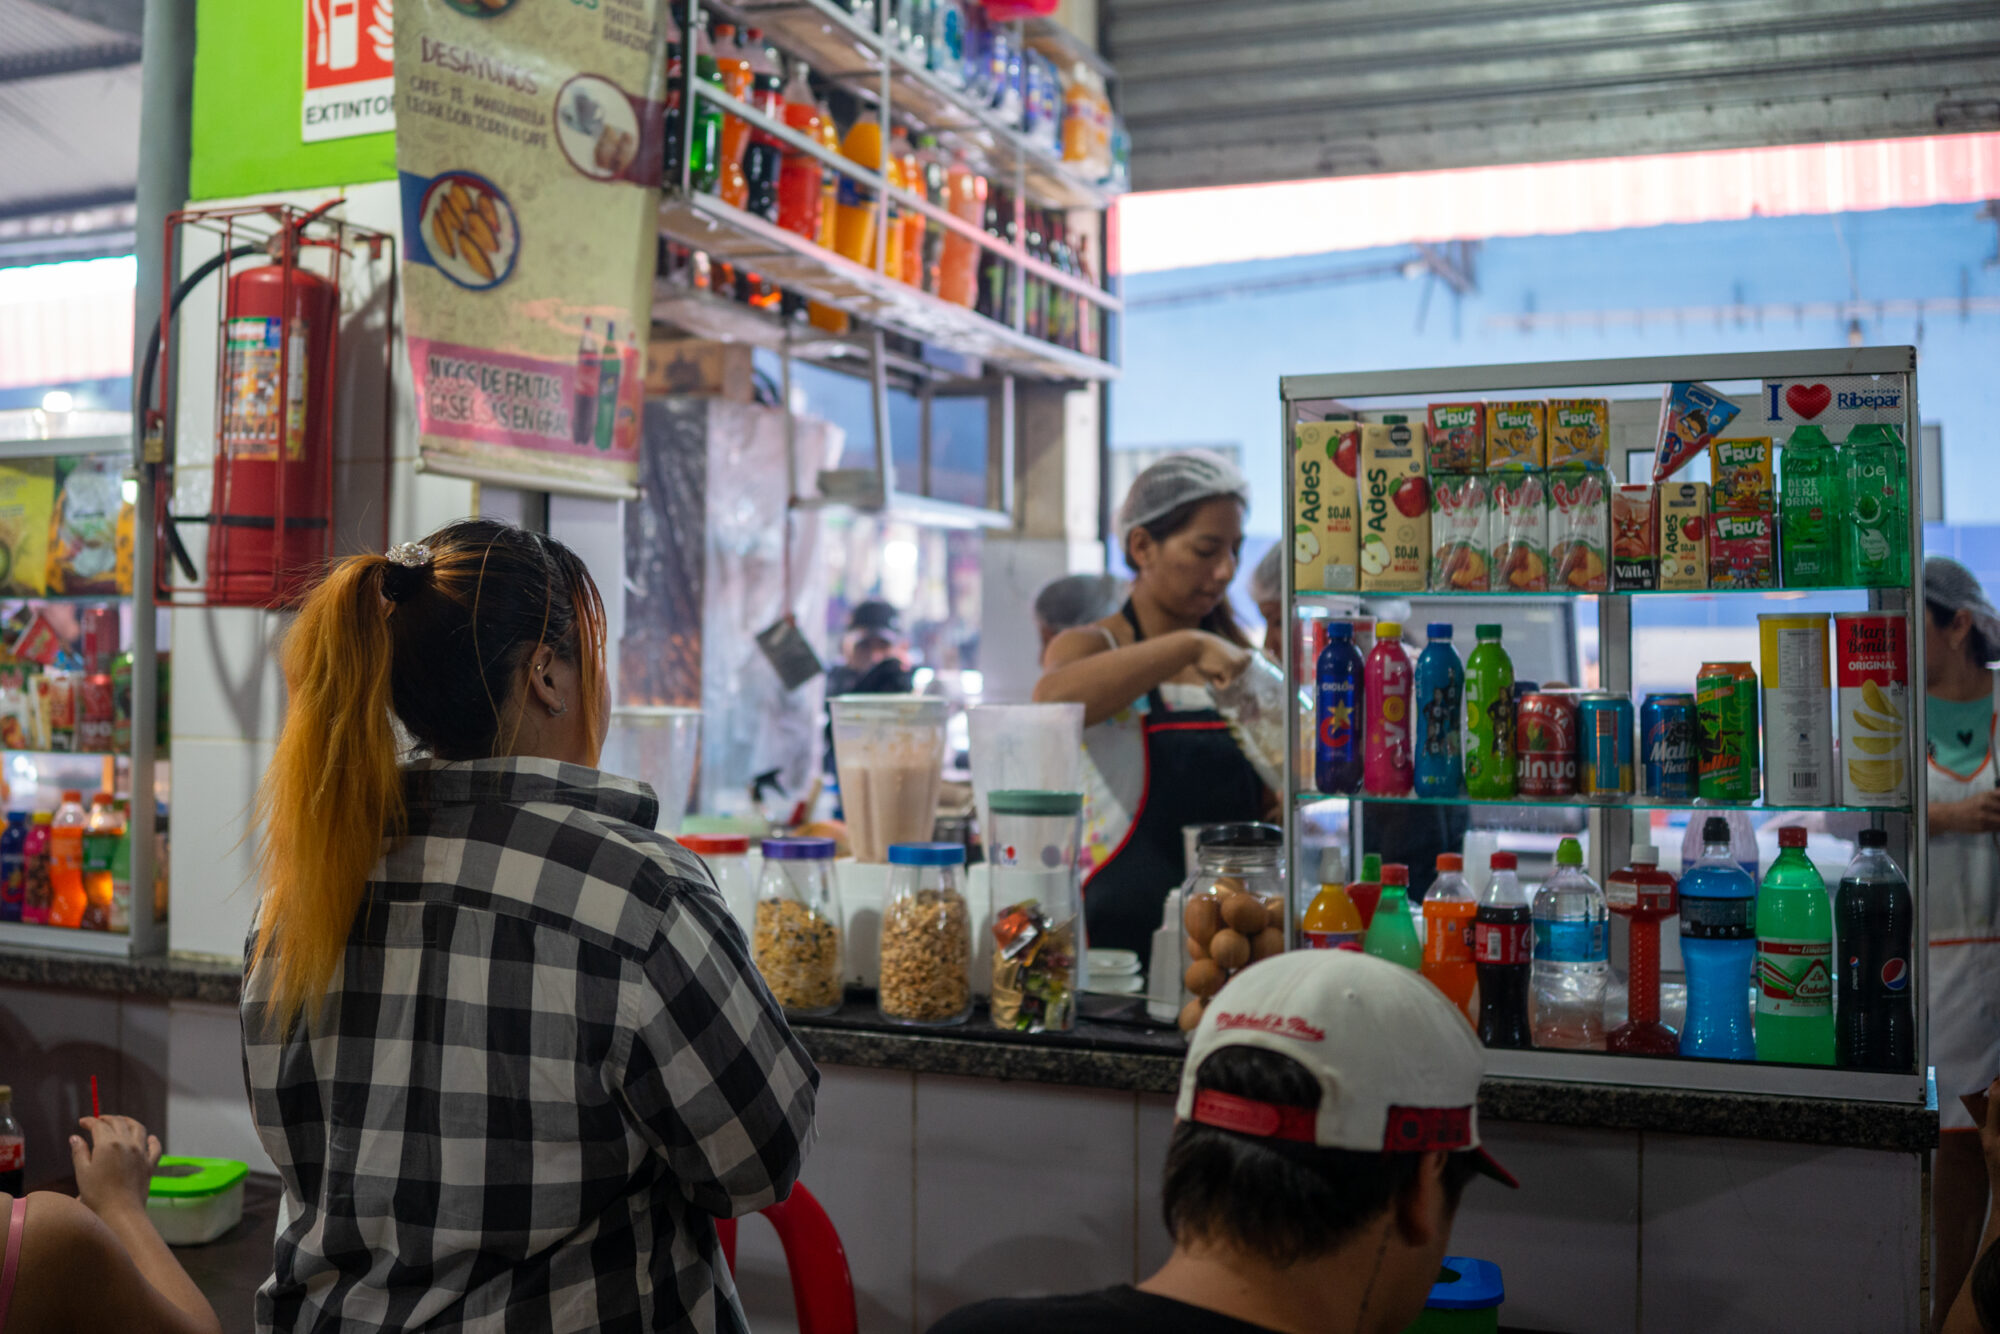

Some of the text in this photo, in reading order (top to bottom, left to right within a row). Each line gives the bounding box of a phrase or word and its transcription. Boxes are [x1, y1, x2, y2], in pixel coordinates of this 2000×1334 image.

[420, 35, 538, 95] DESAYUNOS
[480, 366, 502, 393] DE
[504, 370, 561, 404] FRUTAS
[1766, 383, 1901, 421] I Ribepar
[1301, 460, 1321, 523] AdeS
[1367, 468, 1388, 532] AdeS
[1552, 475, 1602, 514] Pulp
[1787, 478, 1818, 488] ALOE
[1787, 487, 1819, 497] VERA
[1327, 506, 1351, 519] SOJA
[1785, 495, 1823, 507] DRINK
[1665, 513, 1678, 554] AdeS
[1394, 546, 1419, 560] SOJA
[1846, 639, 1897, 654] Bonita
[1848, 661, 1897, 671] ORIGINAL
[1383, 655, 1405, 748] VOLT
[1523, 699, 1570, 730] MALTA
